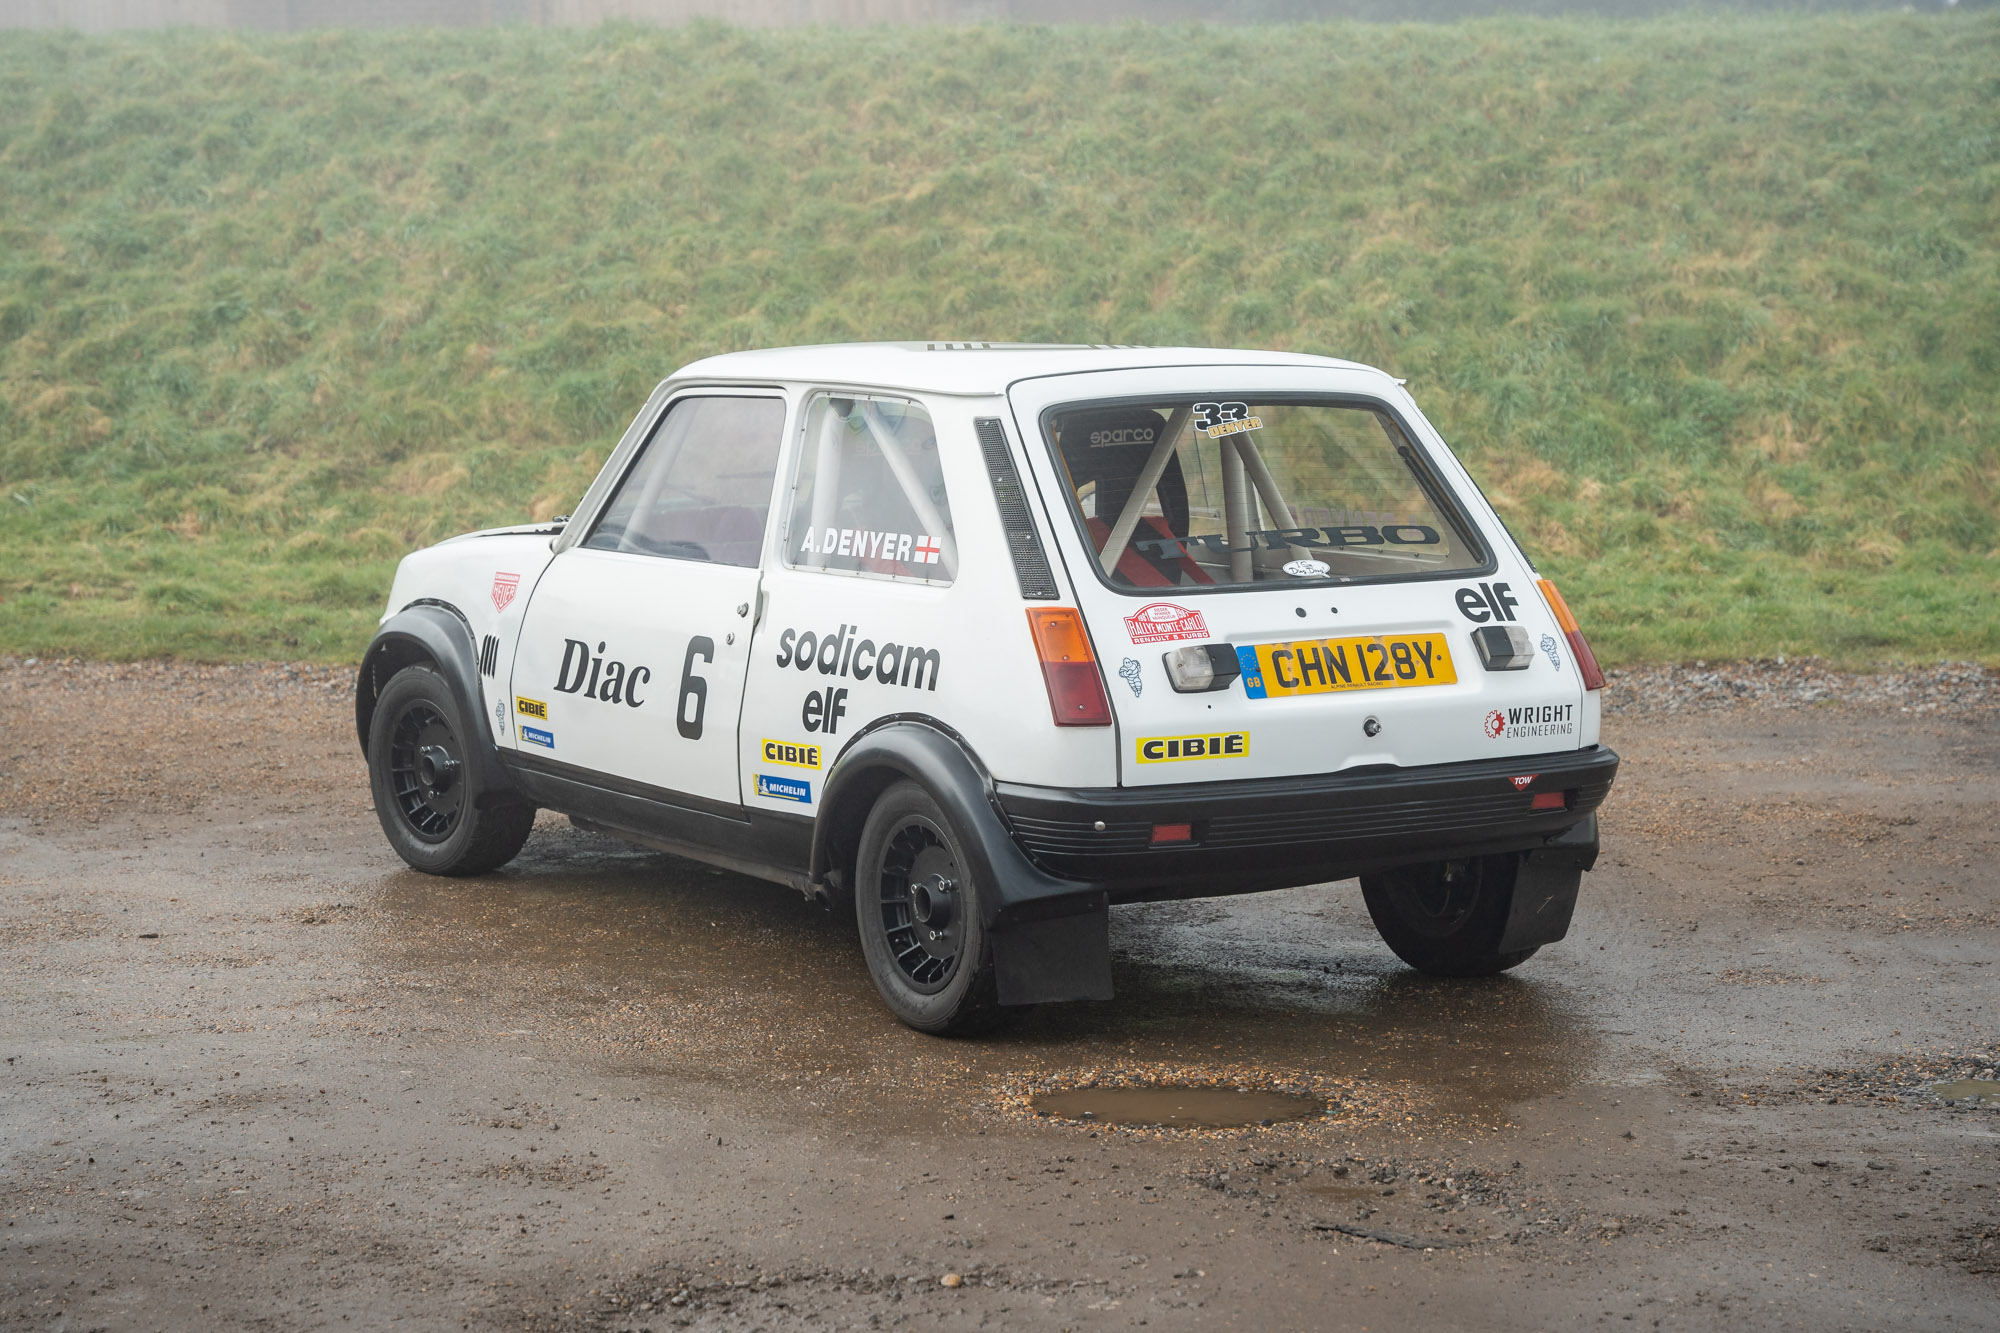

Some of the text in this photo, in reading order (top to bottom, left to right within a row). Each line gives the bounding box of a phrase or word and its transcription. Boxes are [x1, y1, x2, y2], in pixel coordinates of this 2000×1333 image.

[1193, 402, 1248, 431] 33
[1090, 428, 1154, 448] sparco
[1209, 418, 1262, 438] DENYER
[1136, 525, 1440, 560] TURBO
[1455, 583, 1519, 623] elf
[1128, 620, 1157, 635] RALLYE
[1134, 635, 1169, 643] RENAULT
[776, 624, 941, 691] sodicam
[1271, 641, 1435, 689] CHN 128Y
[553, 638, 651, 708] Diac
[1247, 676, 1261, 688] GB
[676, 635, 715, 740] 6
[802, 687, 848, 734] elf
[1508, 704, 1573, 725] WRIGHT
[528, 732, 551, 743] MICHELIN
[1506, 723, 1572, 738] ENGINEERING
[769, 783, 806, 797] MICHELIN
[1514, 776, 1532, 785] TOW
